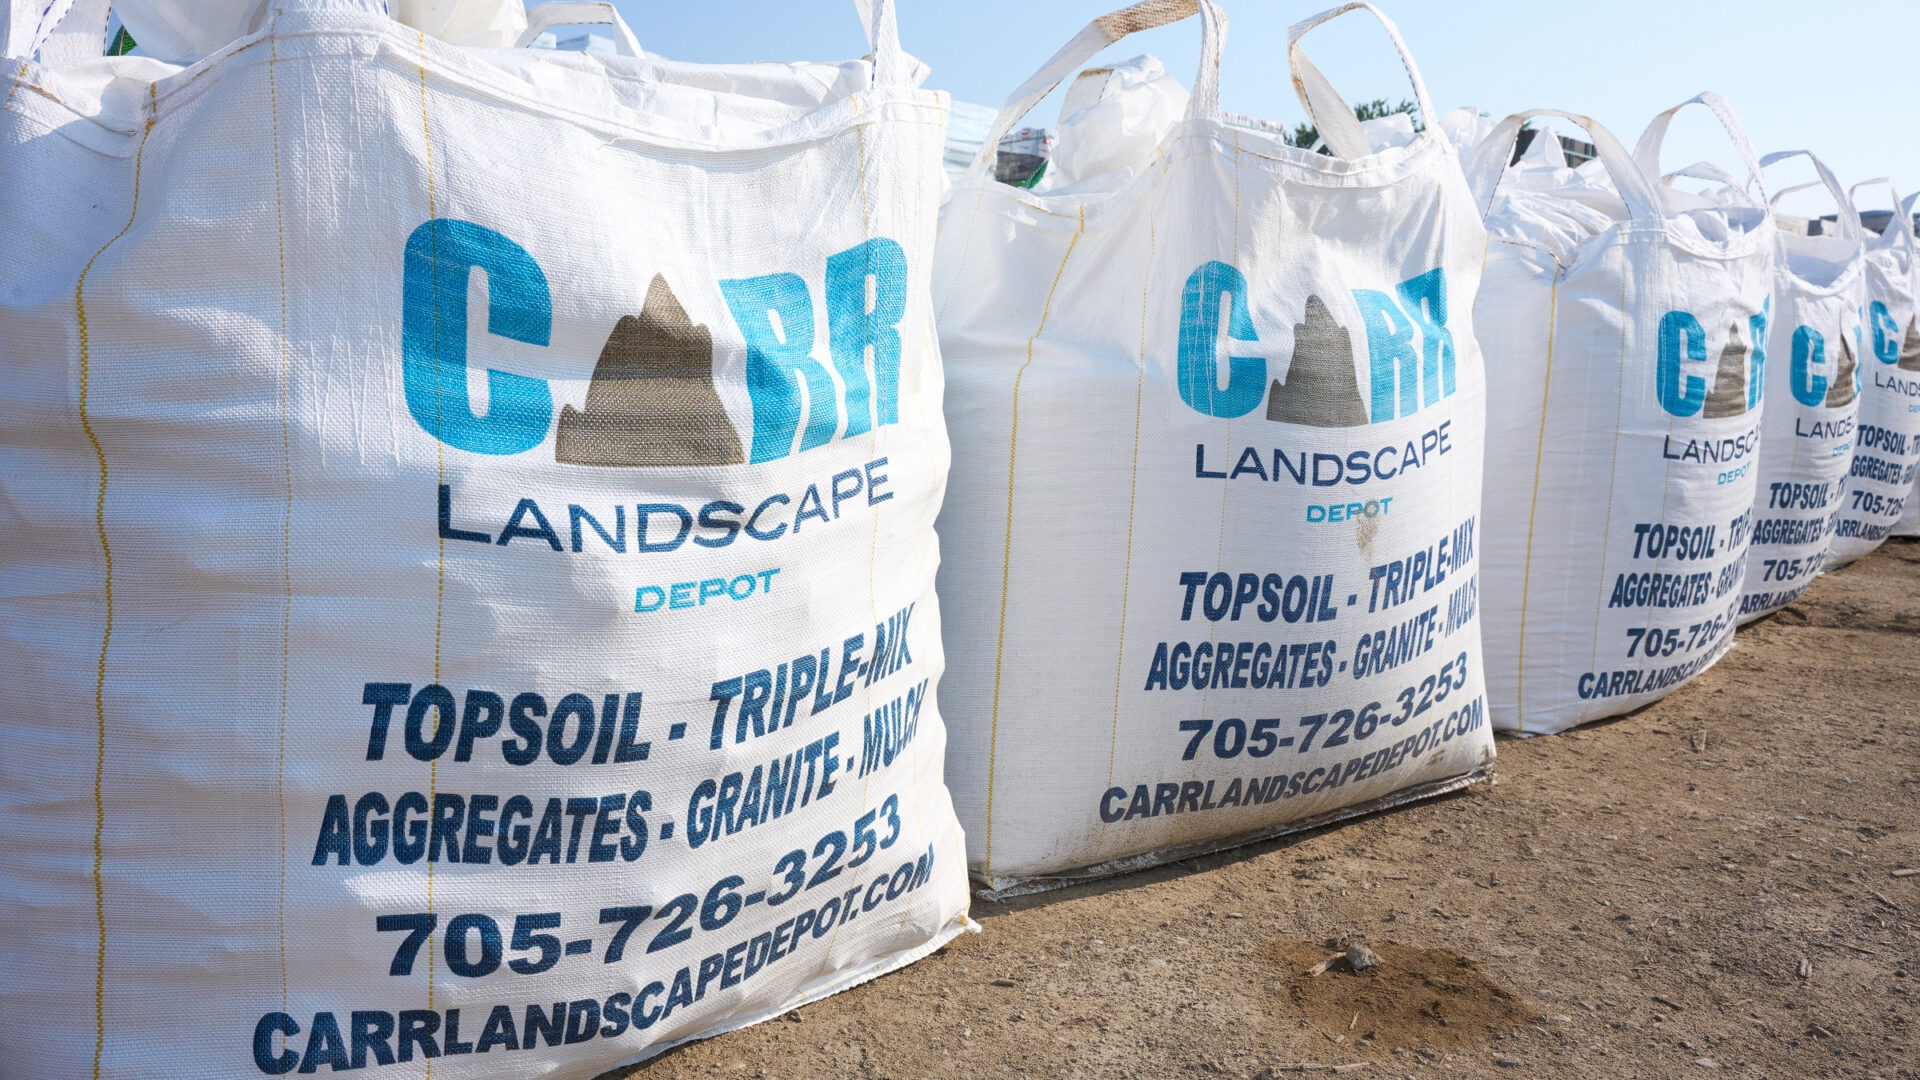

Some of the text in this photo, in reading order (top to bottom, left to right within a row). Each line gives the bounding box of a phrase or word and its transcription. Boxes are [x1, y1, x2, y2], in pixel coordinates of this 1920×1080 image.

[1195, 419, 1452, 486] LANDSCAPE
[1718, 461, 1751, 485] DEPOT
[1850, 455, 1903, 485] GGREGATES
[1857, 424, 1906, 455] TOPSOIL
[438, 457, 894, 554] LANDSCAPE
[1306, 498, 1393, 523] DEPOT
[1769, 482, 1829, 510] TOPSOIL
[1633, 523, 1716, 561] TOPSOIL
[1750, 517, 1824, 546] AGGREGATES
[634, 568, 781, 613] DEPOT
[1179, 571, 1337, 623] TOPSOIL
[1368, 515, 1475, 613] TRIPLE-MIX
[1608, 571, 1712, 609] AGGREGATES
[1144, 640, 1337, 691] AGGREGATES
[1353, 604, 1438, 680] GRANITE
[362, 682, 651, 766] TOPSOIL
[708, 601, 916, 750] TRIPLE-MIX
[1179, 651, 1467, 761] 705-726-3253
[311, 790, 653, 866] AGGREGATES
[686, 741, 841, 850] GRANITE
[858, 677, 929, 780] MULCH
[1100, 695, 1484, 824] CARRLANDSCAPEDEPOT.COM
[376, 793, 900, 977] 705-726-3253
[253, 843, 935, 1076] CARRLANDSCAPEDEPOT.COM
